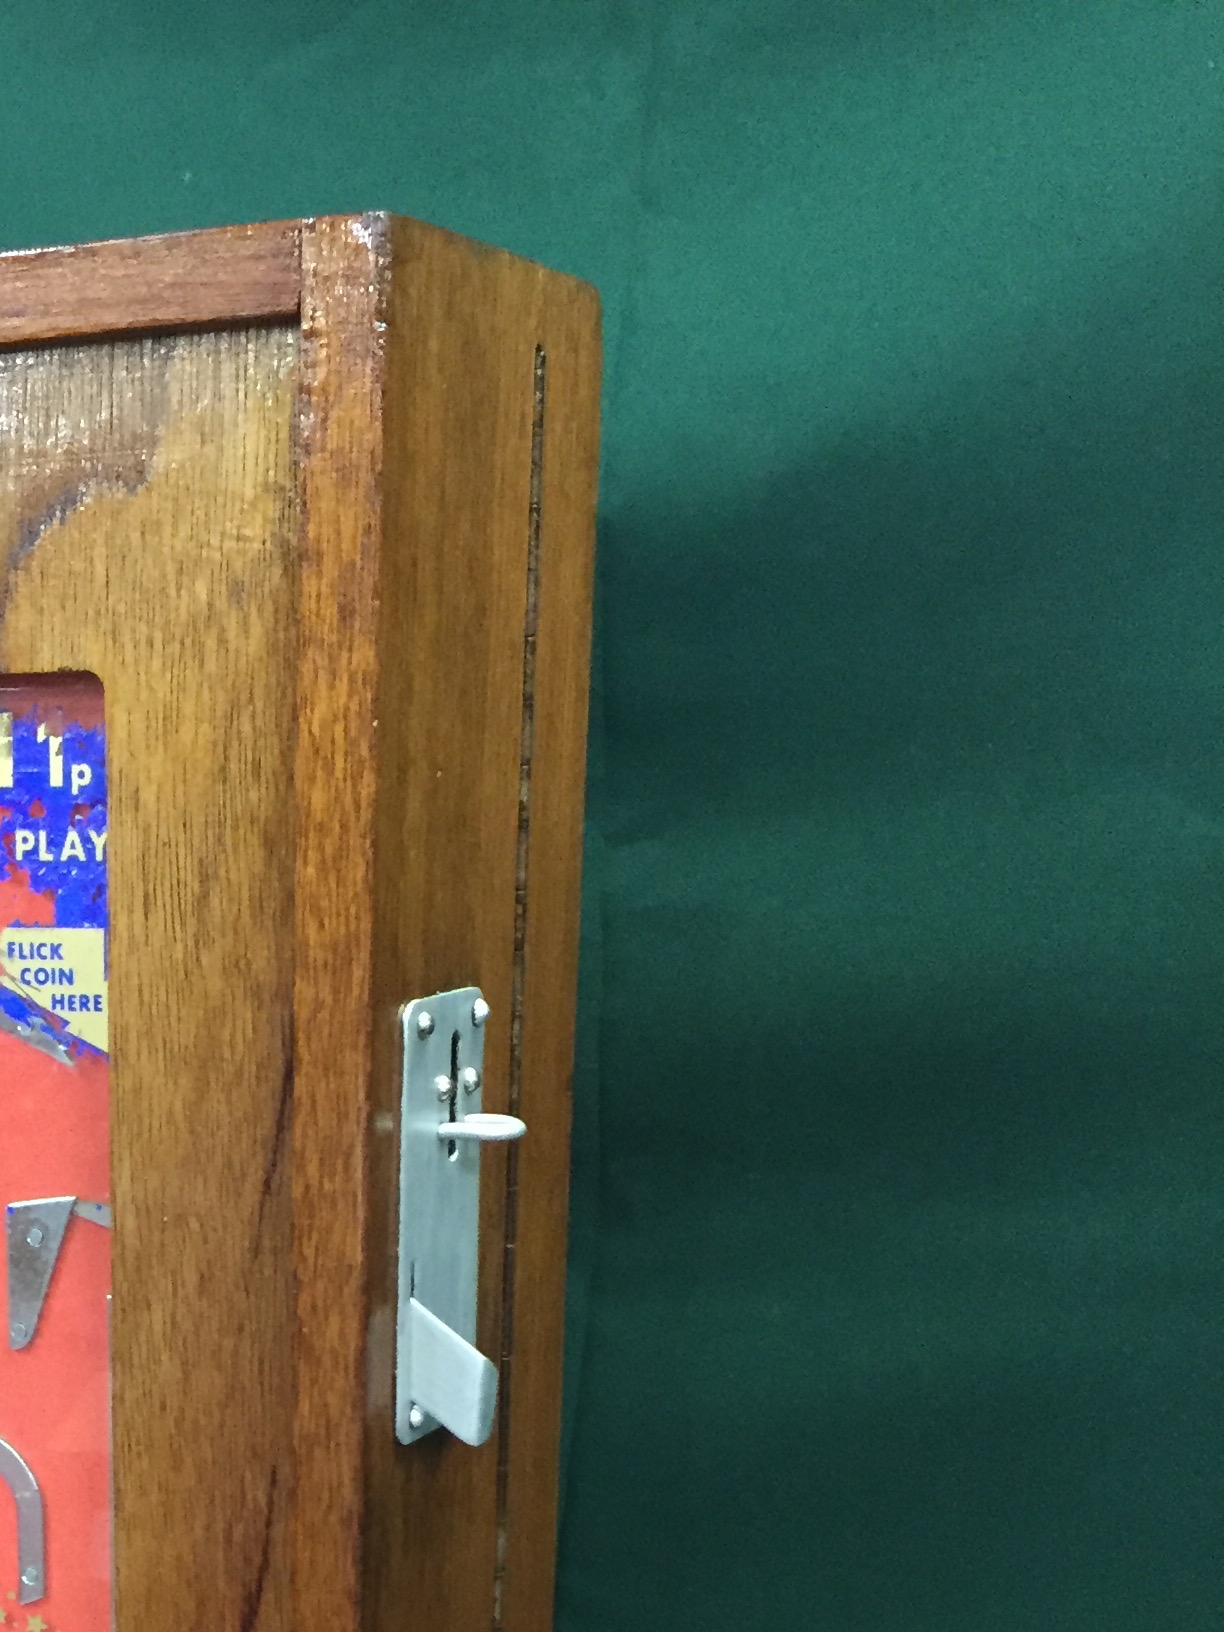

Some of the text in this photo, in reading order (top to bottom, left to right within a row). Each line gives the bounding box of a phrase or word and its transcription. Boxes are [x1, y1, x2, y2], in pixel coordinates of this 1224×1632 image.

[14, 828, 108, 862] PLAY
[7, 941, 64, 961] FLICK
[20, 968, 74, 986] COIN
[51, 993, 103, 1013] HERE
